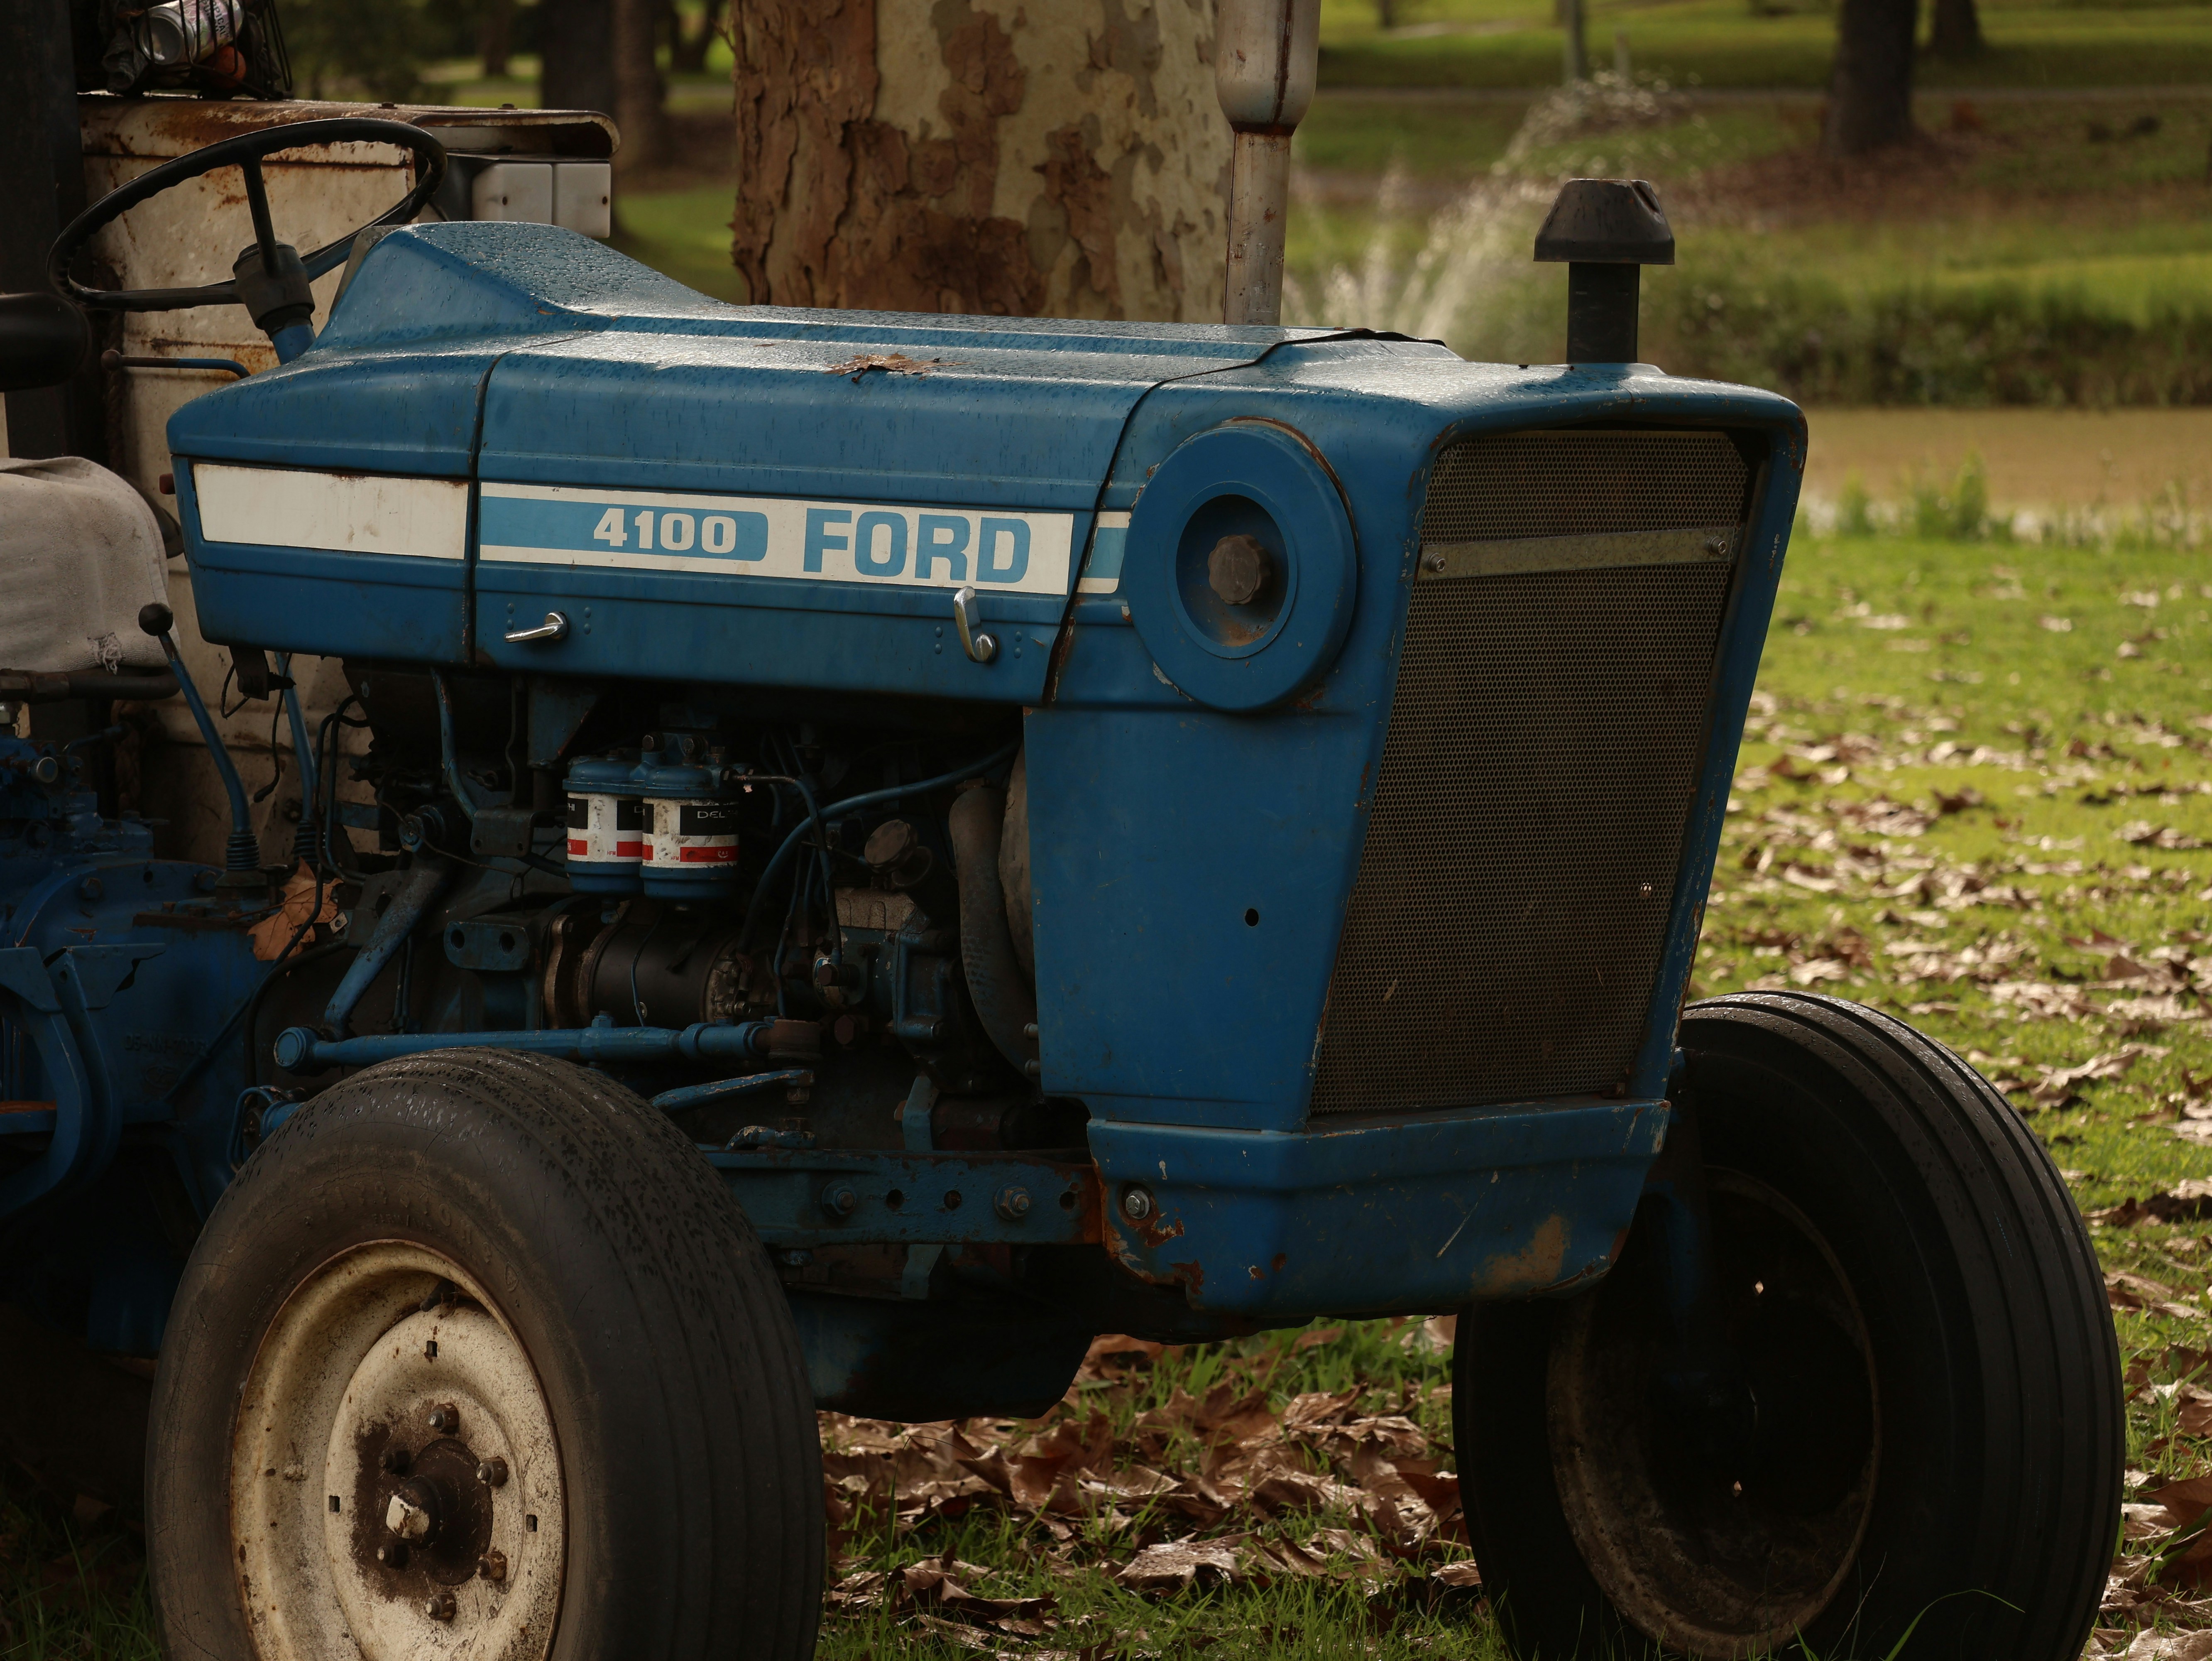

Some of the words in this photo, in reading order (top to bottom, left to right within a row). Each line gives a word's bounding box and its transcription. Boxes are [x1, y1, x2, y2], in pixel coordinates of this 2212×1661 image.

[594, 508, 736, 554] 4100
[803, 508, 1031, 583] FORD
[250, 1284, 274, 1320] SPEED
